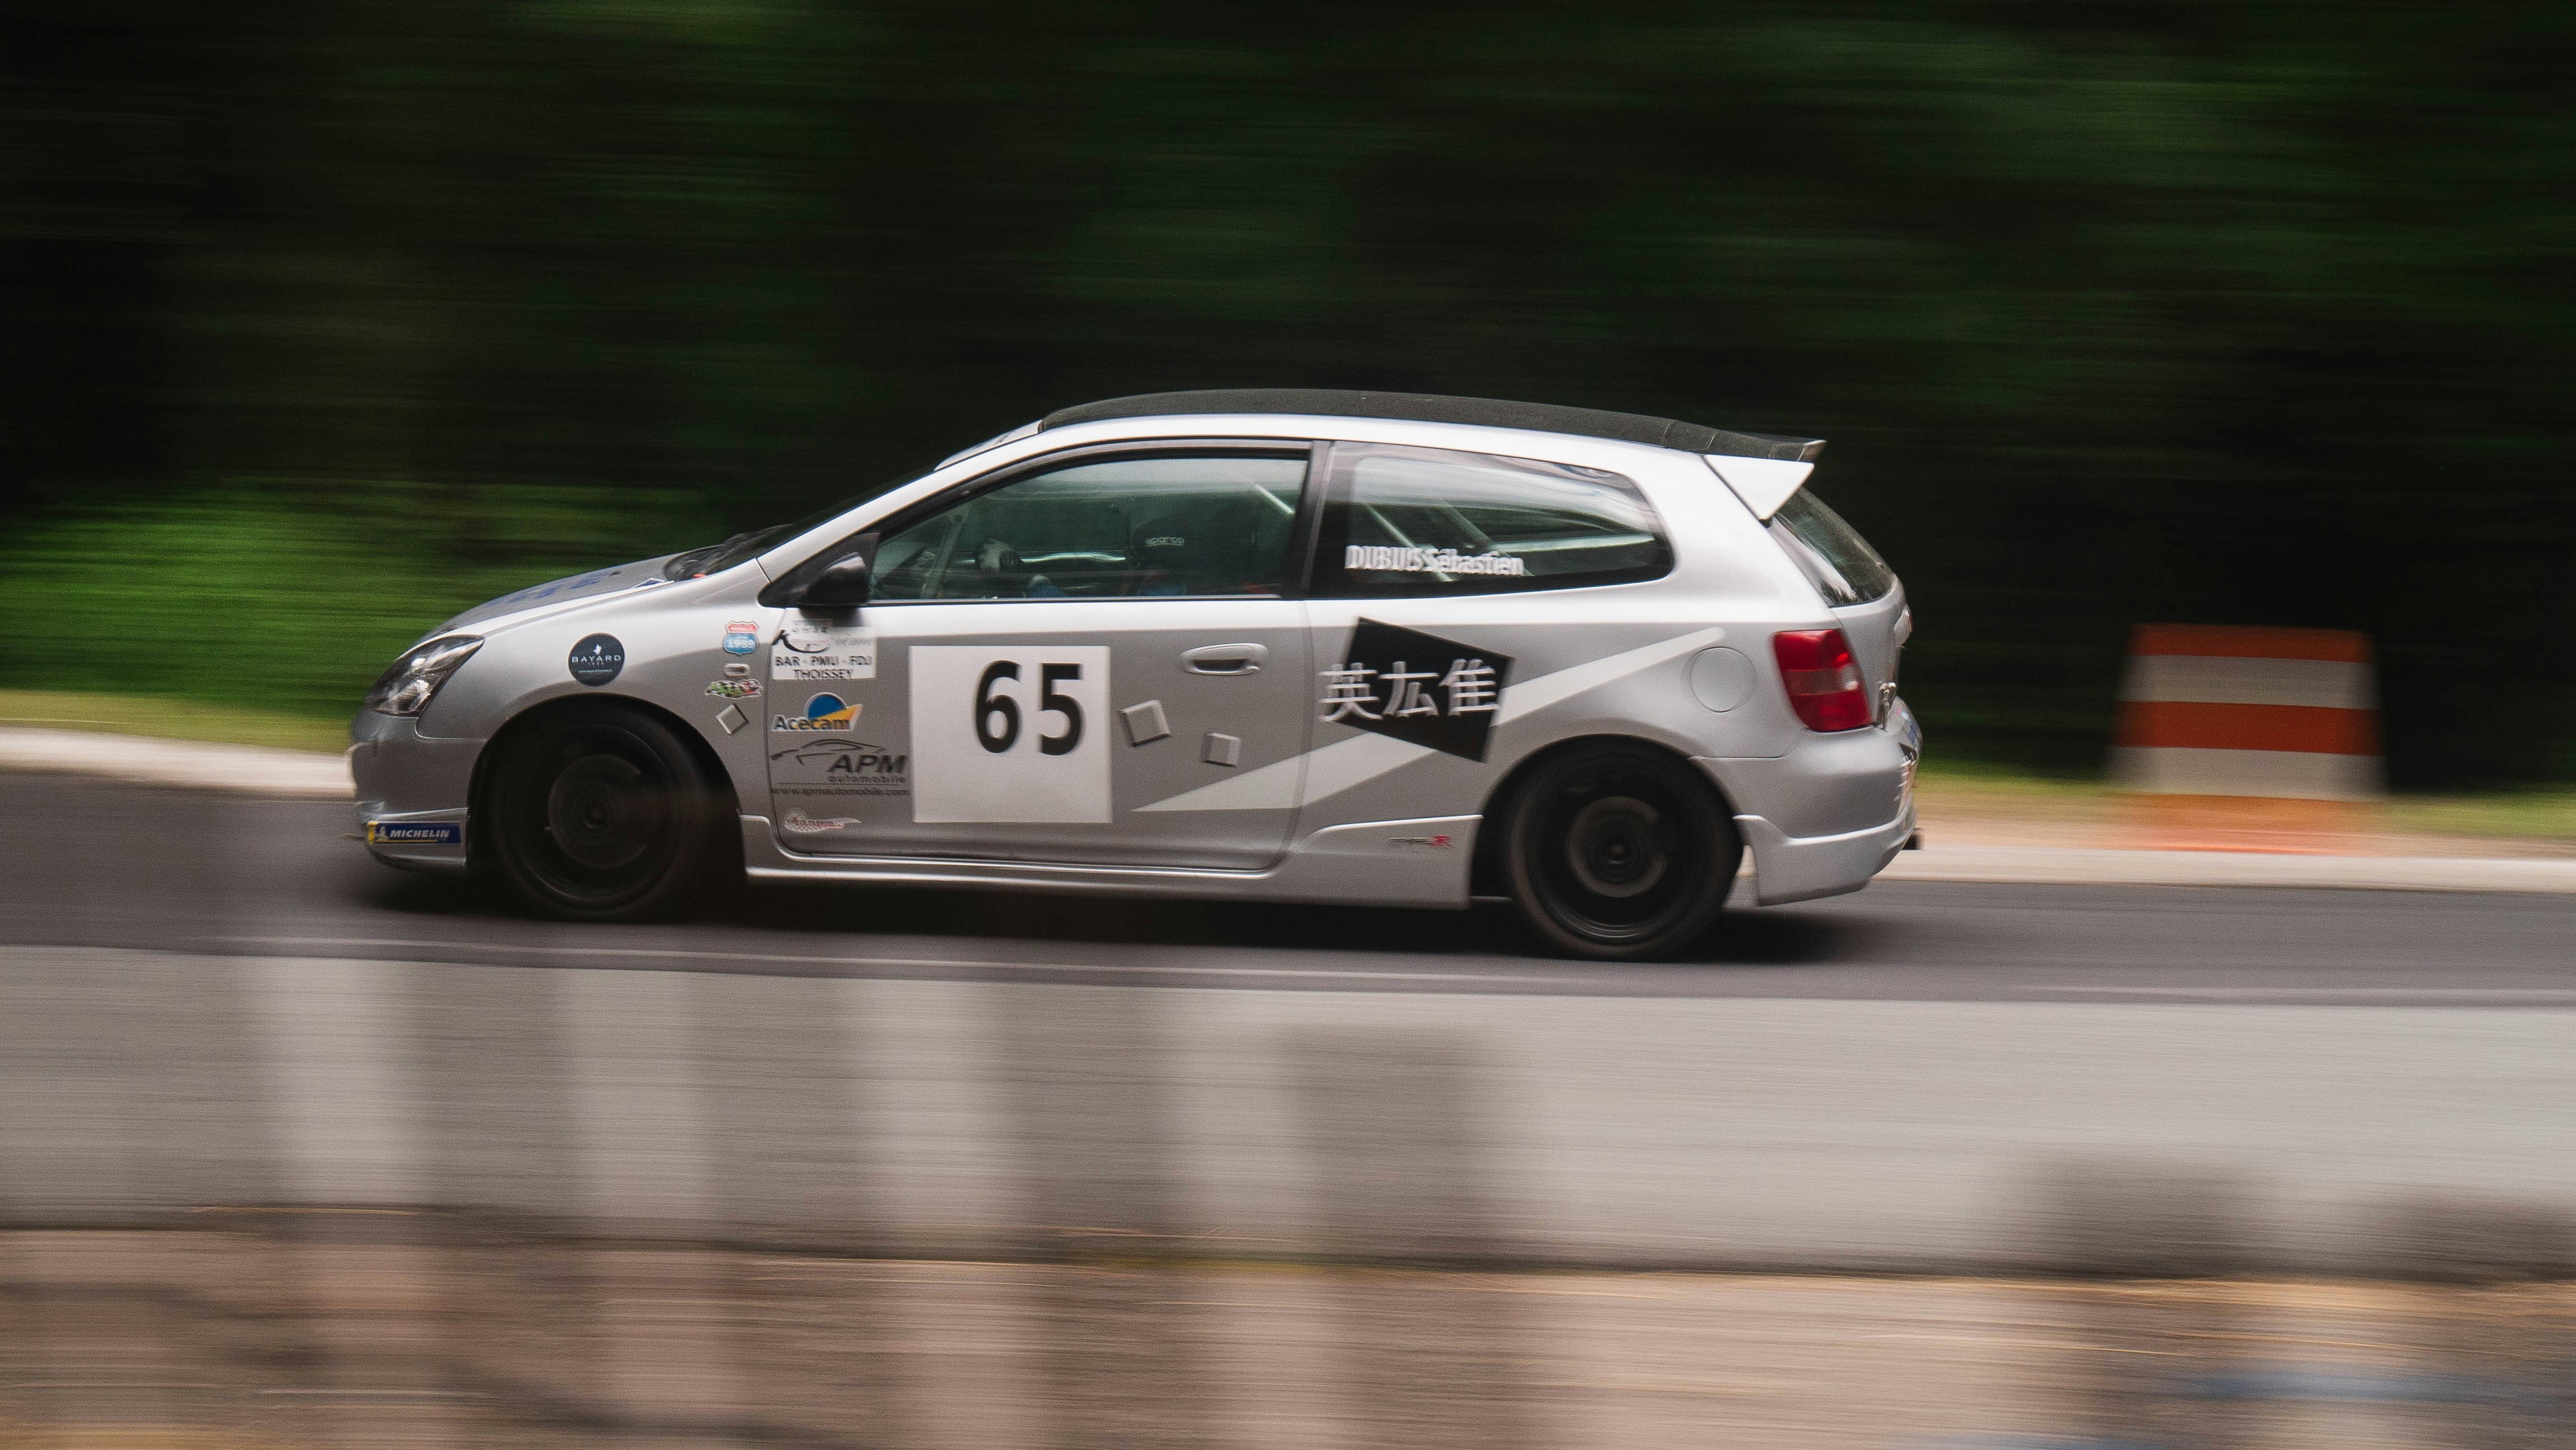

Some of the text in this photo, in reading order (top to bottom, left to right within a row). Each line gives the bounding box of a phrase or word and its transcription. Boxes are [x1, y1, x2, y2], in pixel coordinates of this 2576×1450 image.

[572, 655, 622, 663] BAYARD
[775, 656, 801, 667] BAR
[811, 655, 840, 667] PMU
[974, 659, 1085, 755] 65
[774, 714, 850, 731] Acecam
[826, 754, 909, 773] APM
